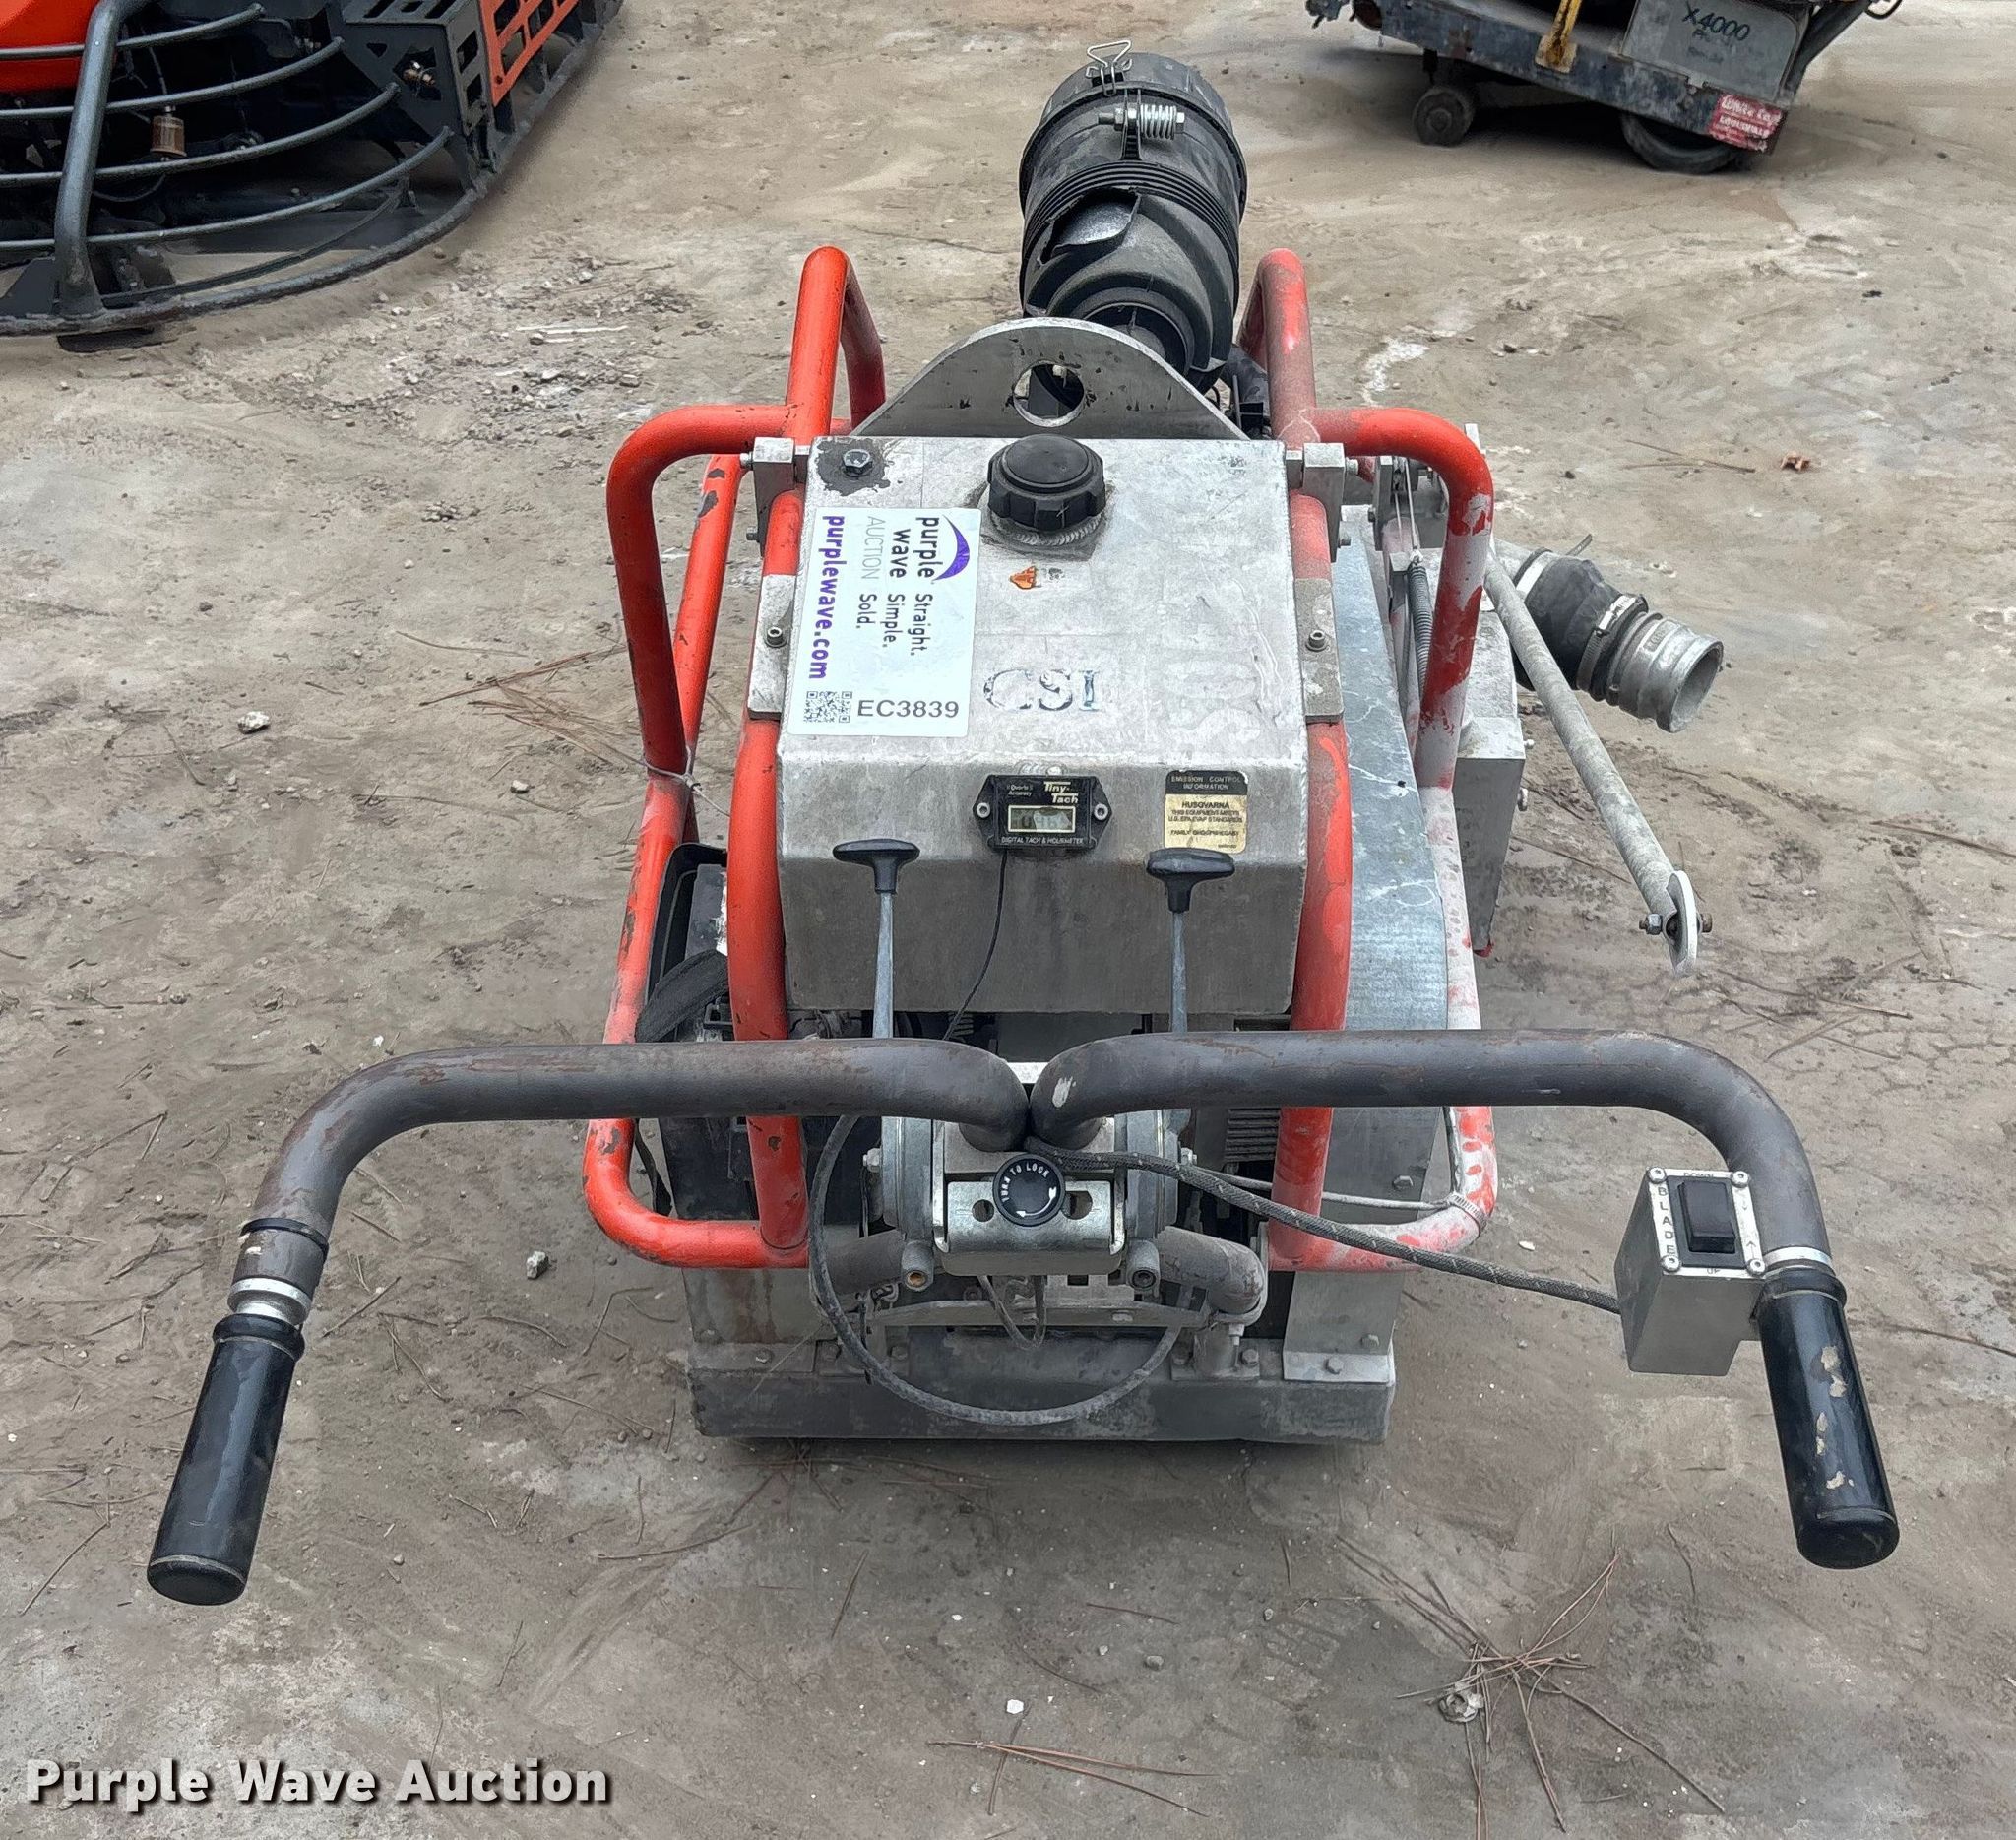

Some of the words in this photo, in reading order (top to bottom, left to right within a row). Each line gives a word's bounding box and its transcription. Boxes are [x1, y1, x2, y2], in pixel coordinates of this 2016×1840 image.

[1682, 2, 1751, 41] X4000
[861, 516, 886, 579] AUCTION
[889, 529, 911, 578] wave
[914, 517, 943, 578] purple
[809, 516, 847, 679] purplewave.com
[856, 594, 877, 629] Sold.
[880, 594, 905, 648] Simple.
[908, 594, 933, 656] Straight.
[857, 700, 959, 719] EC3839
[983, 668, 1100, 711] CSI
[1050, 793, 1079, 804] Tach
[1181, 800, 1229, 809] HUSQVARNA
[1000, 1176, 1011, 1202] TURN
[1009, 1165, 1022, 1176] TO
[1026, 1162, 1050, 1178] LOCK
[1658, 1186, 1675, 1255] BLADE
